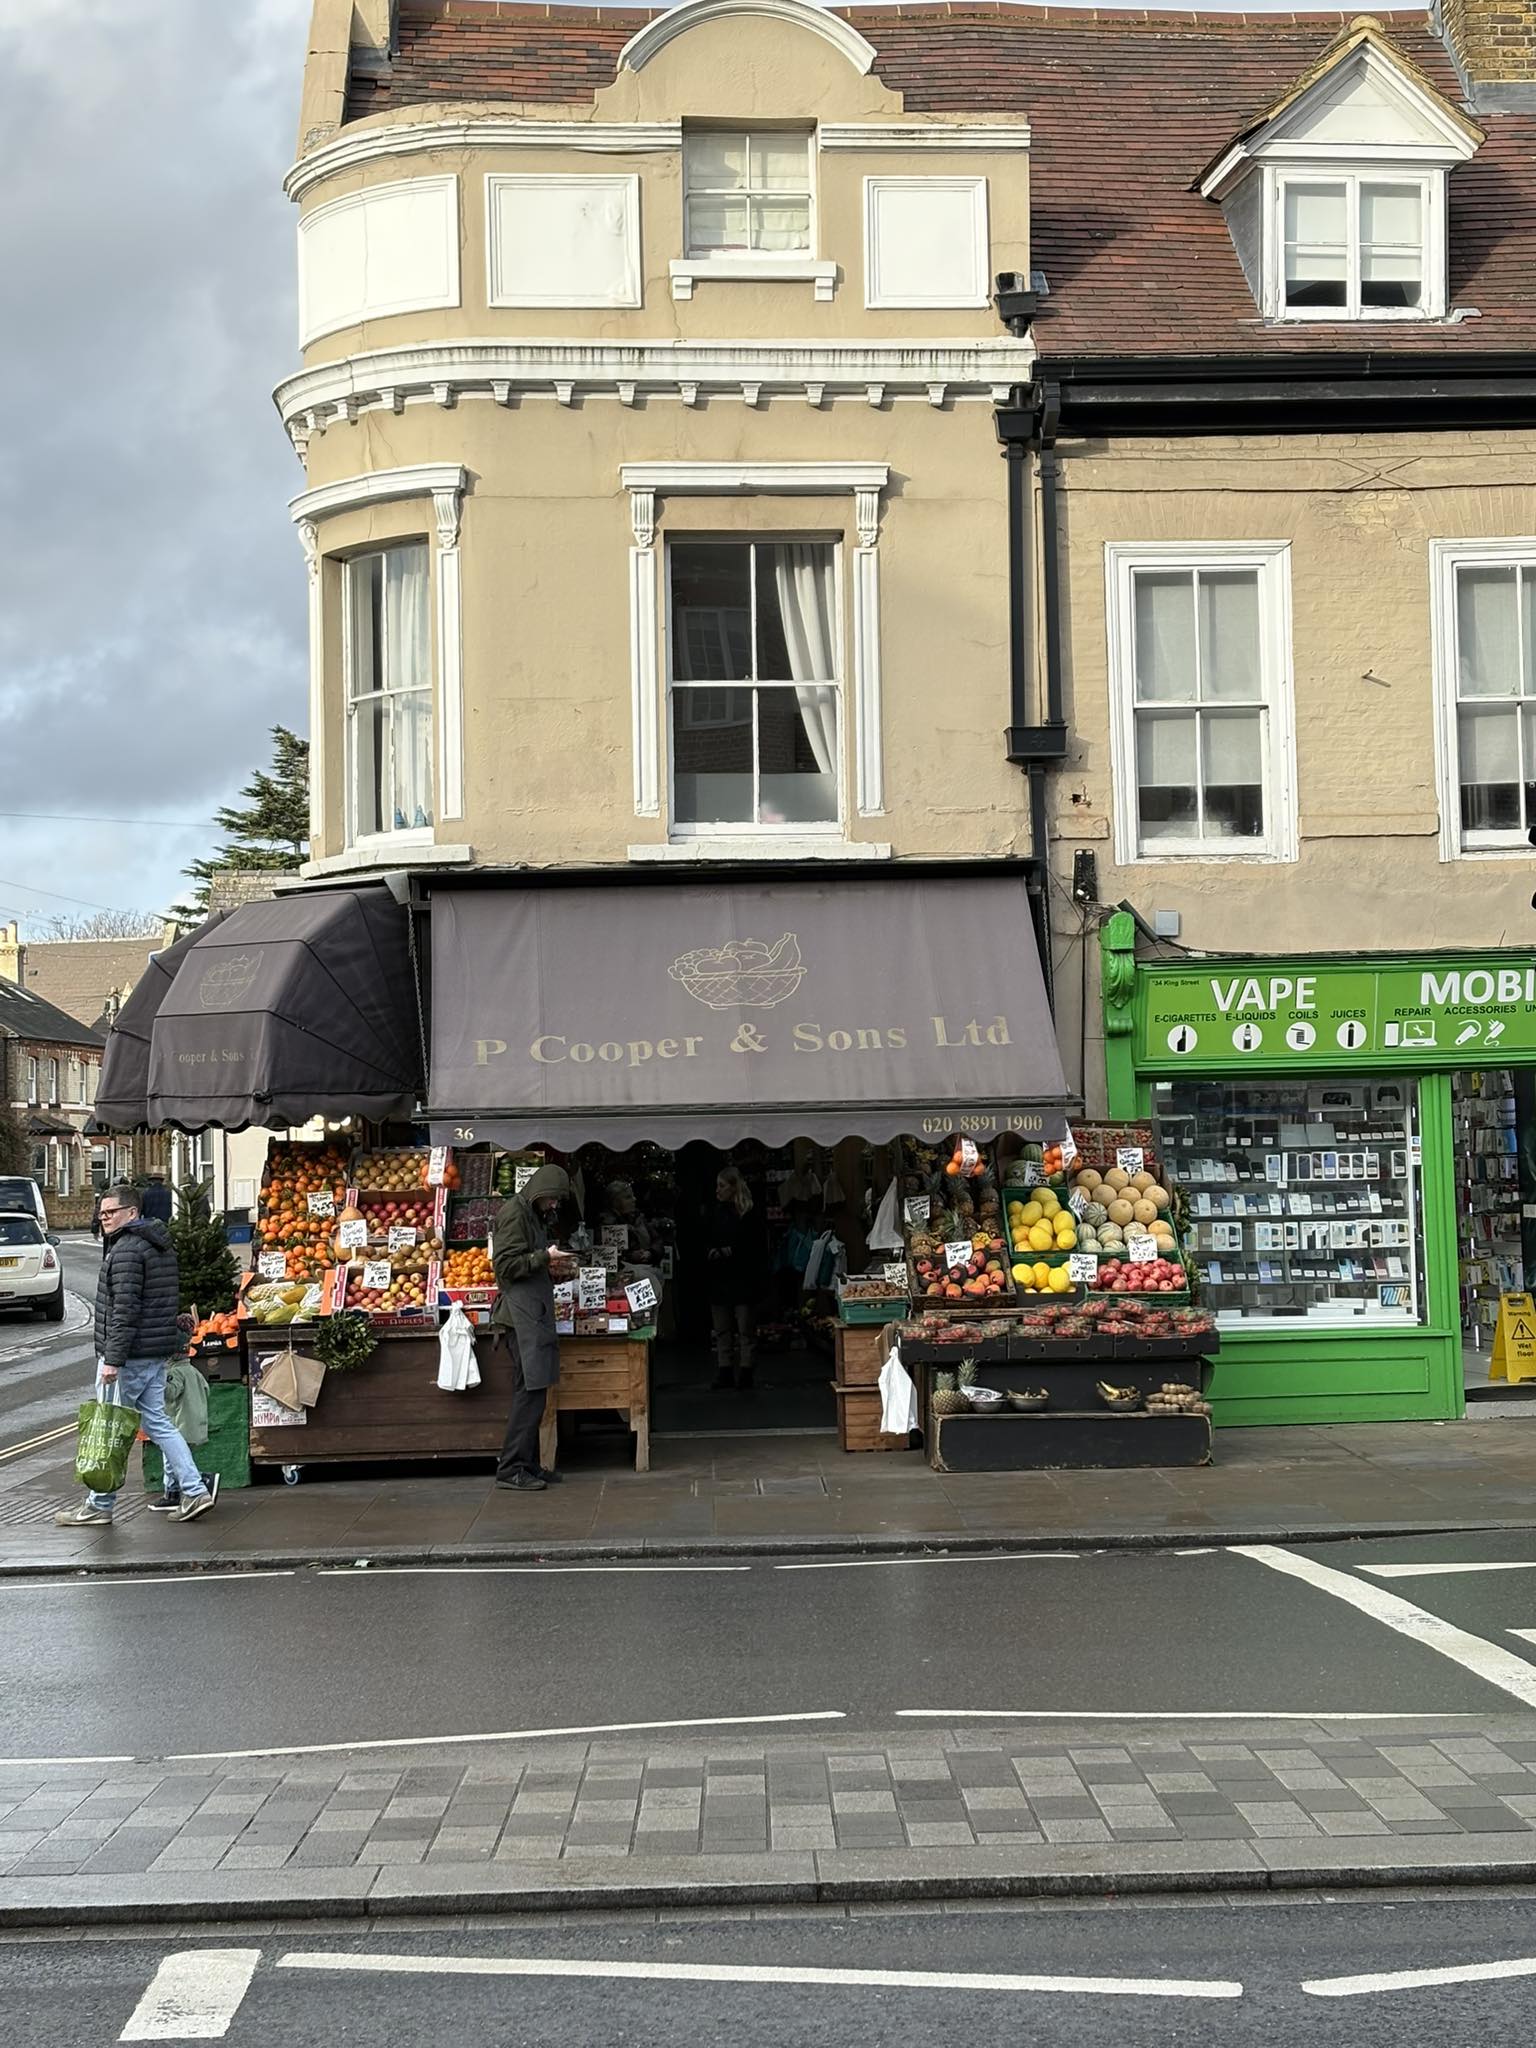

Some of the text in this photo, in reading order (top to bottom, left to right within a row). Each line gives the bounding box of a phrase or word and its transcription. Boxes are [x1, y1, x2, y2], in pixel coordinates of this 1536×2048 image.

[1210, 977, 1317, 1011] VAPE
[1420, 969, 1536, 1005] MOBI
[1154, 1009, 1367, 1023] E-CIGARETTES E-LIQUIDS COILS JUICES
[1394, 1007, 1431, 1017] REPAIR
[1444, 1005, 1517, 1015] ACCESSORIES
[473, 1015, 1014, 1068] P Cooper & Sons Ltd
[922, 1114, 1043, 1134] 020 8891 1900
[453, 1127, 475, 1141] 36
[1517, 1342, 1532, 1350] Wet
[1517, 1350, 1534, 1358] floor
